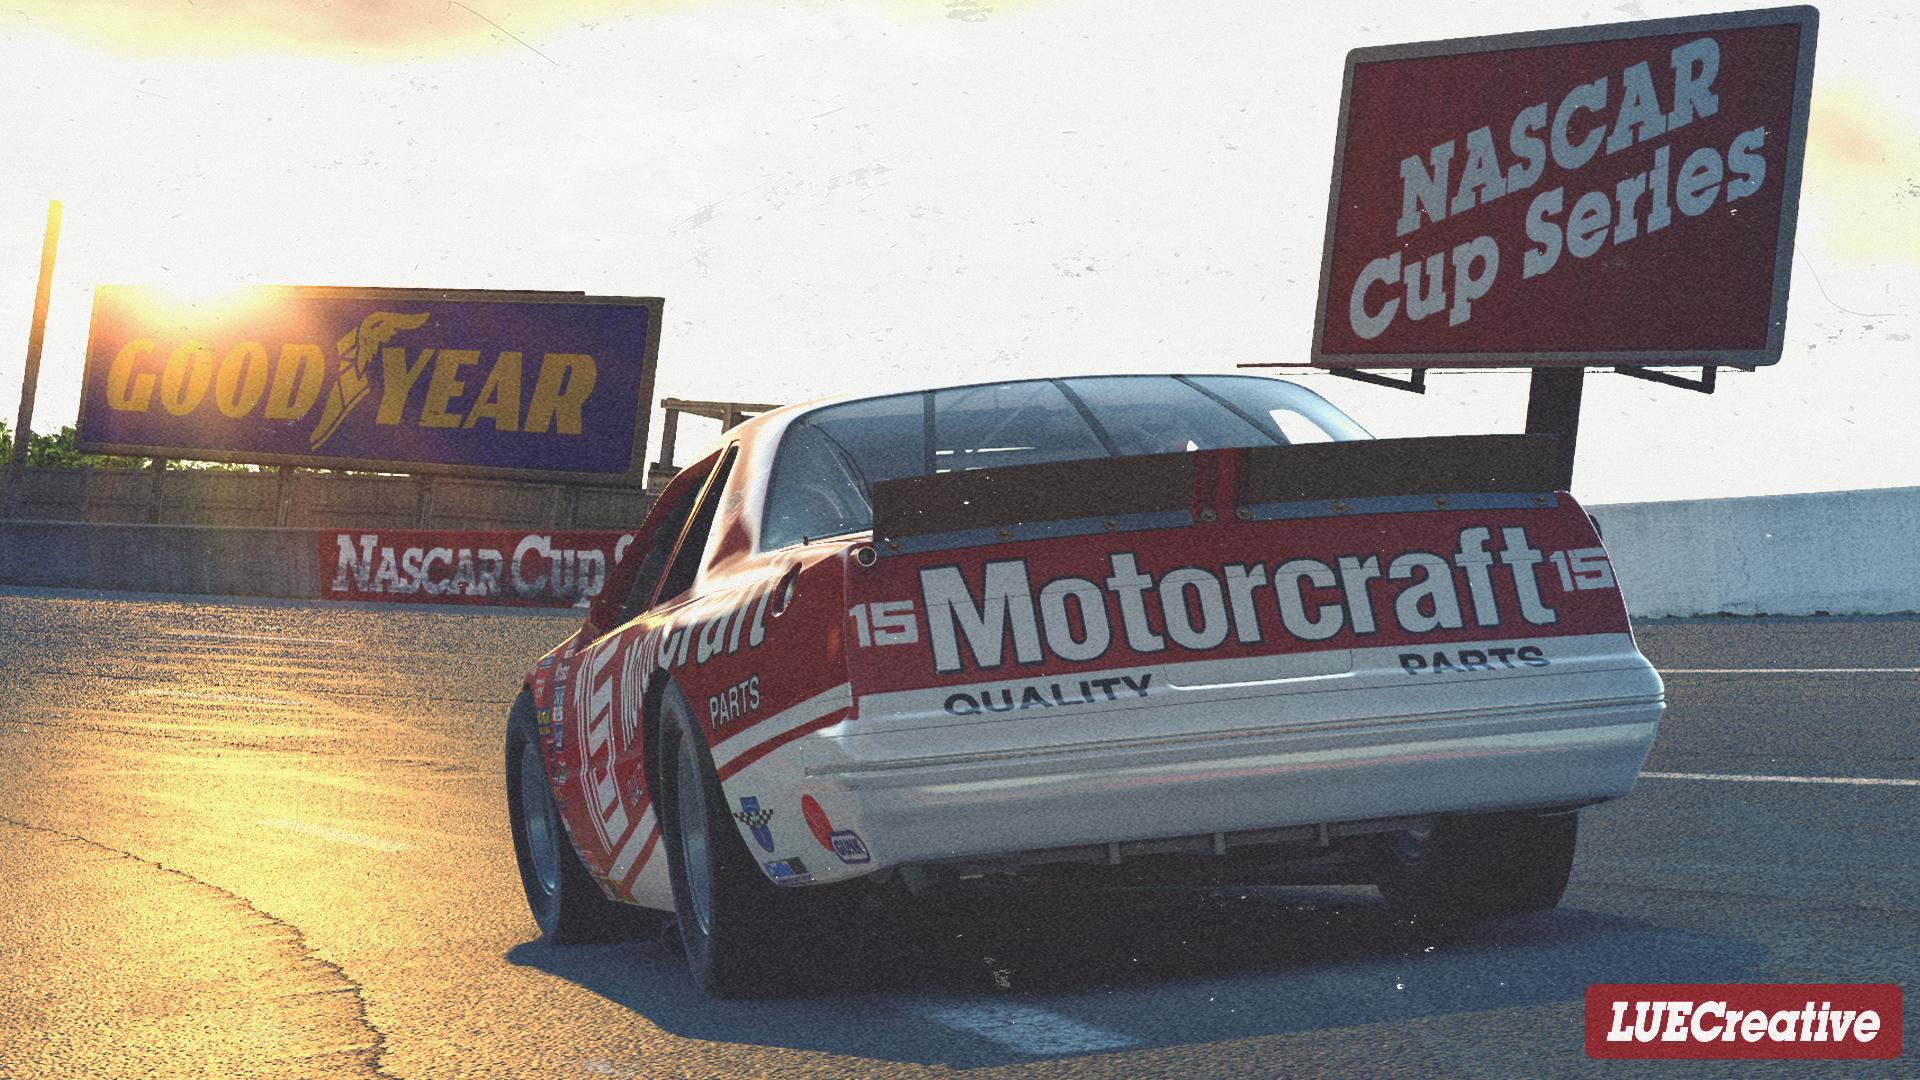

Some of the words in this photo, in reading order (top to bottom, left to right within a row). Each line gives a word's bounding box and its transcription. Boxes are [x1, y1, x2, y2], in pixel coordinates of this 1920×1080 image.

[1396, 38, 1720, 237] NASCAR
[1349, 234, 1499, 339] Cup
[1523, 126, 1767, 279] Series
[331, 534, 504, 596] NASCAR
[511, 534, 606, 608] Cup
[849, 600, 919, 647] 15
[919, 526, 1557, 675] Motorcraft
[1549, 547, 1616, 592] 15
[708, 673, 761, 730] PARTS
[943, 674, 1153, 716] QUALITY
[1398, 646, 1551, 676] PARTS
